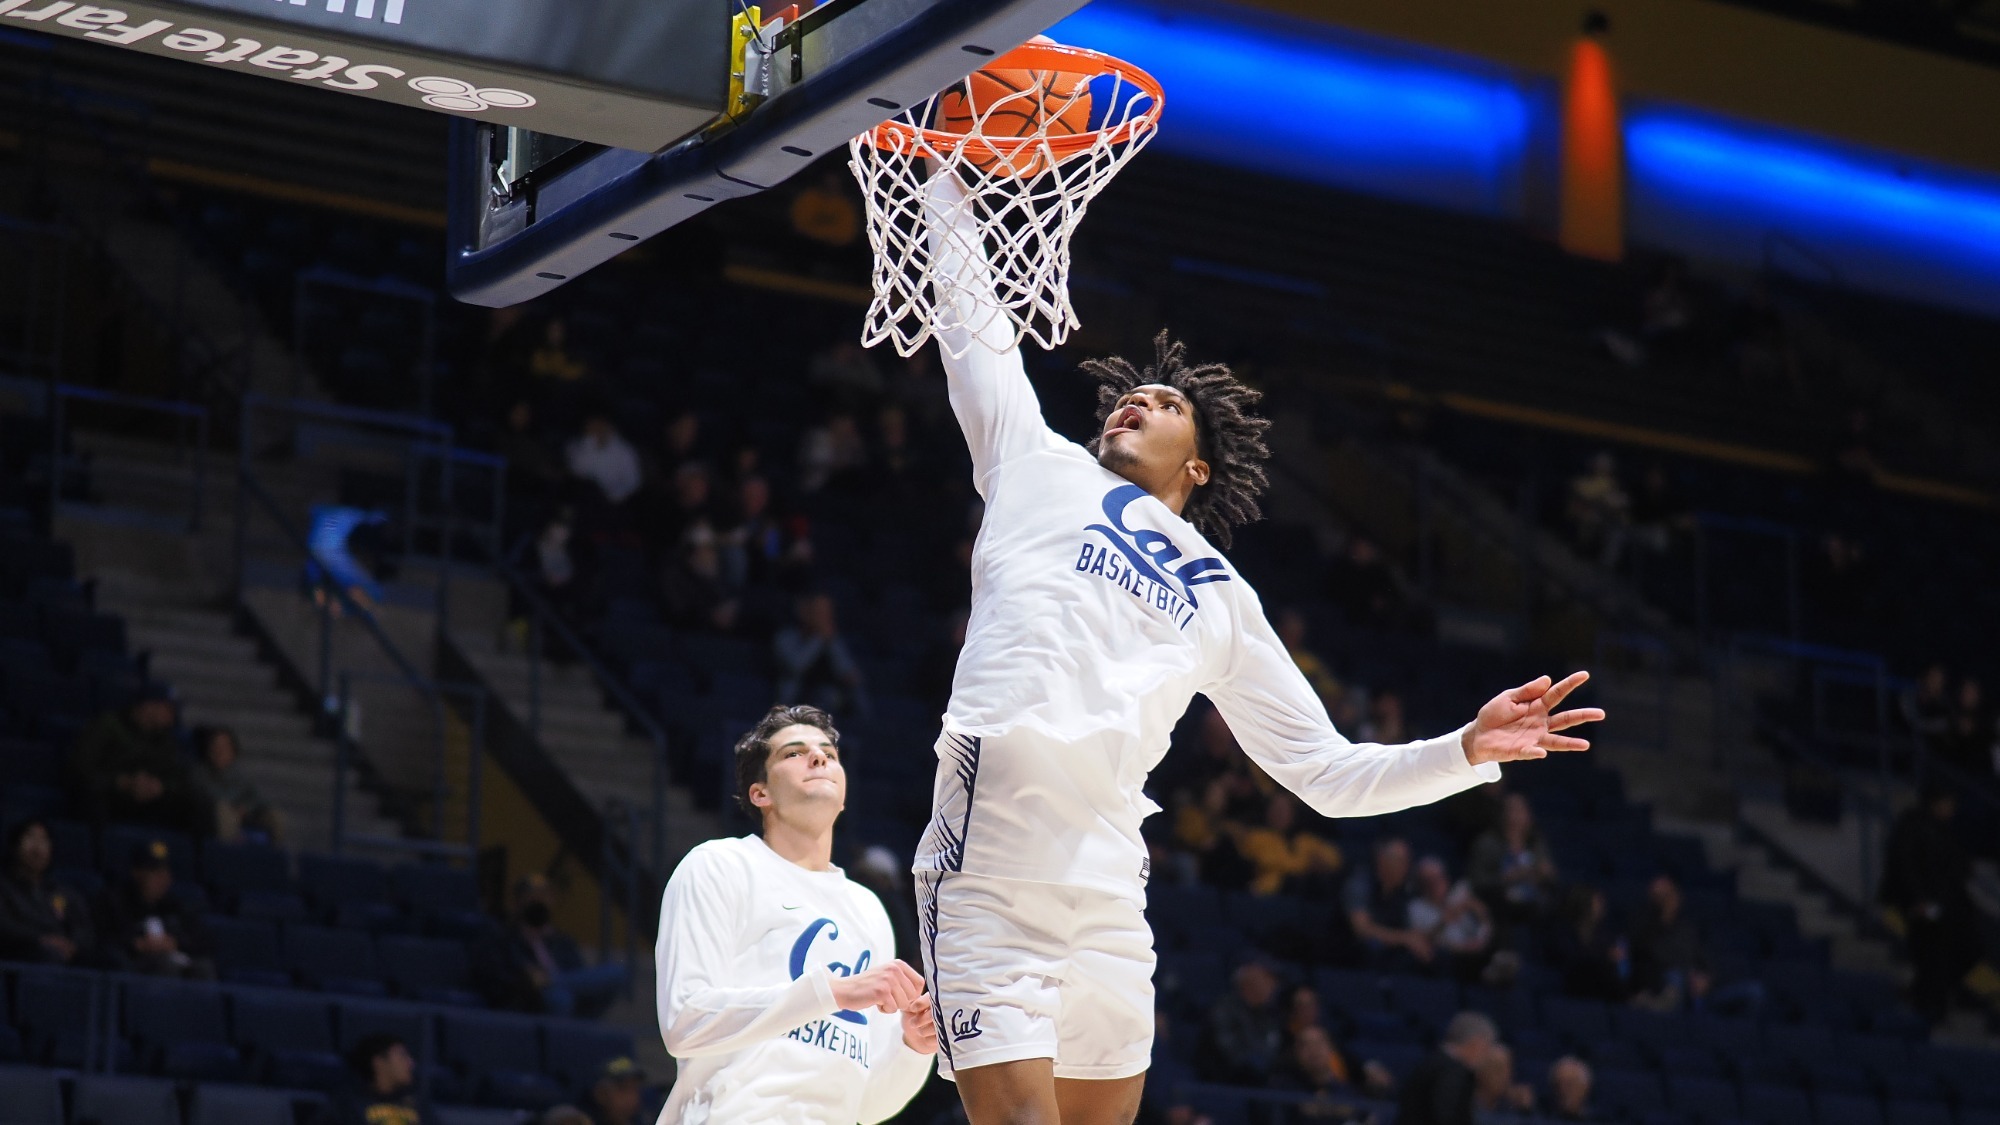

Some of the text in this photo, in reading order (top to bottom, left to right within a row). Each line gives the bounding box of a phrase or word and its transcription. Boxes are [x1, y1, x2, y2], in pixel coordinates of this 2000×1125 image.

[1083, 484, 1231, 610] Cal
[1075, 543, 1195, 631] BASKETBALL
[781, 1019, 869, 1069] ASKETBAL
[951, 1008, 983, 1043] Cal
